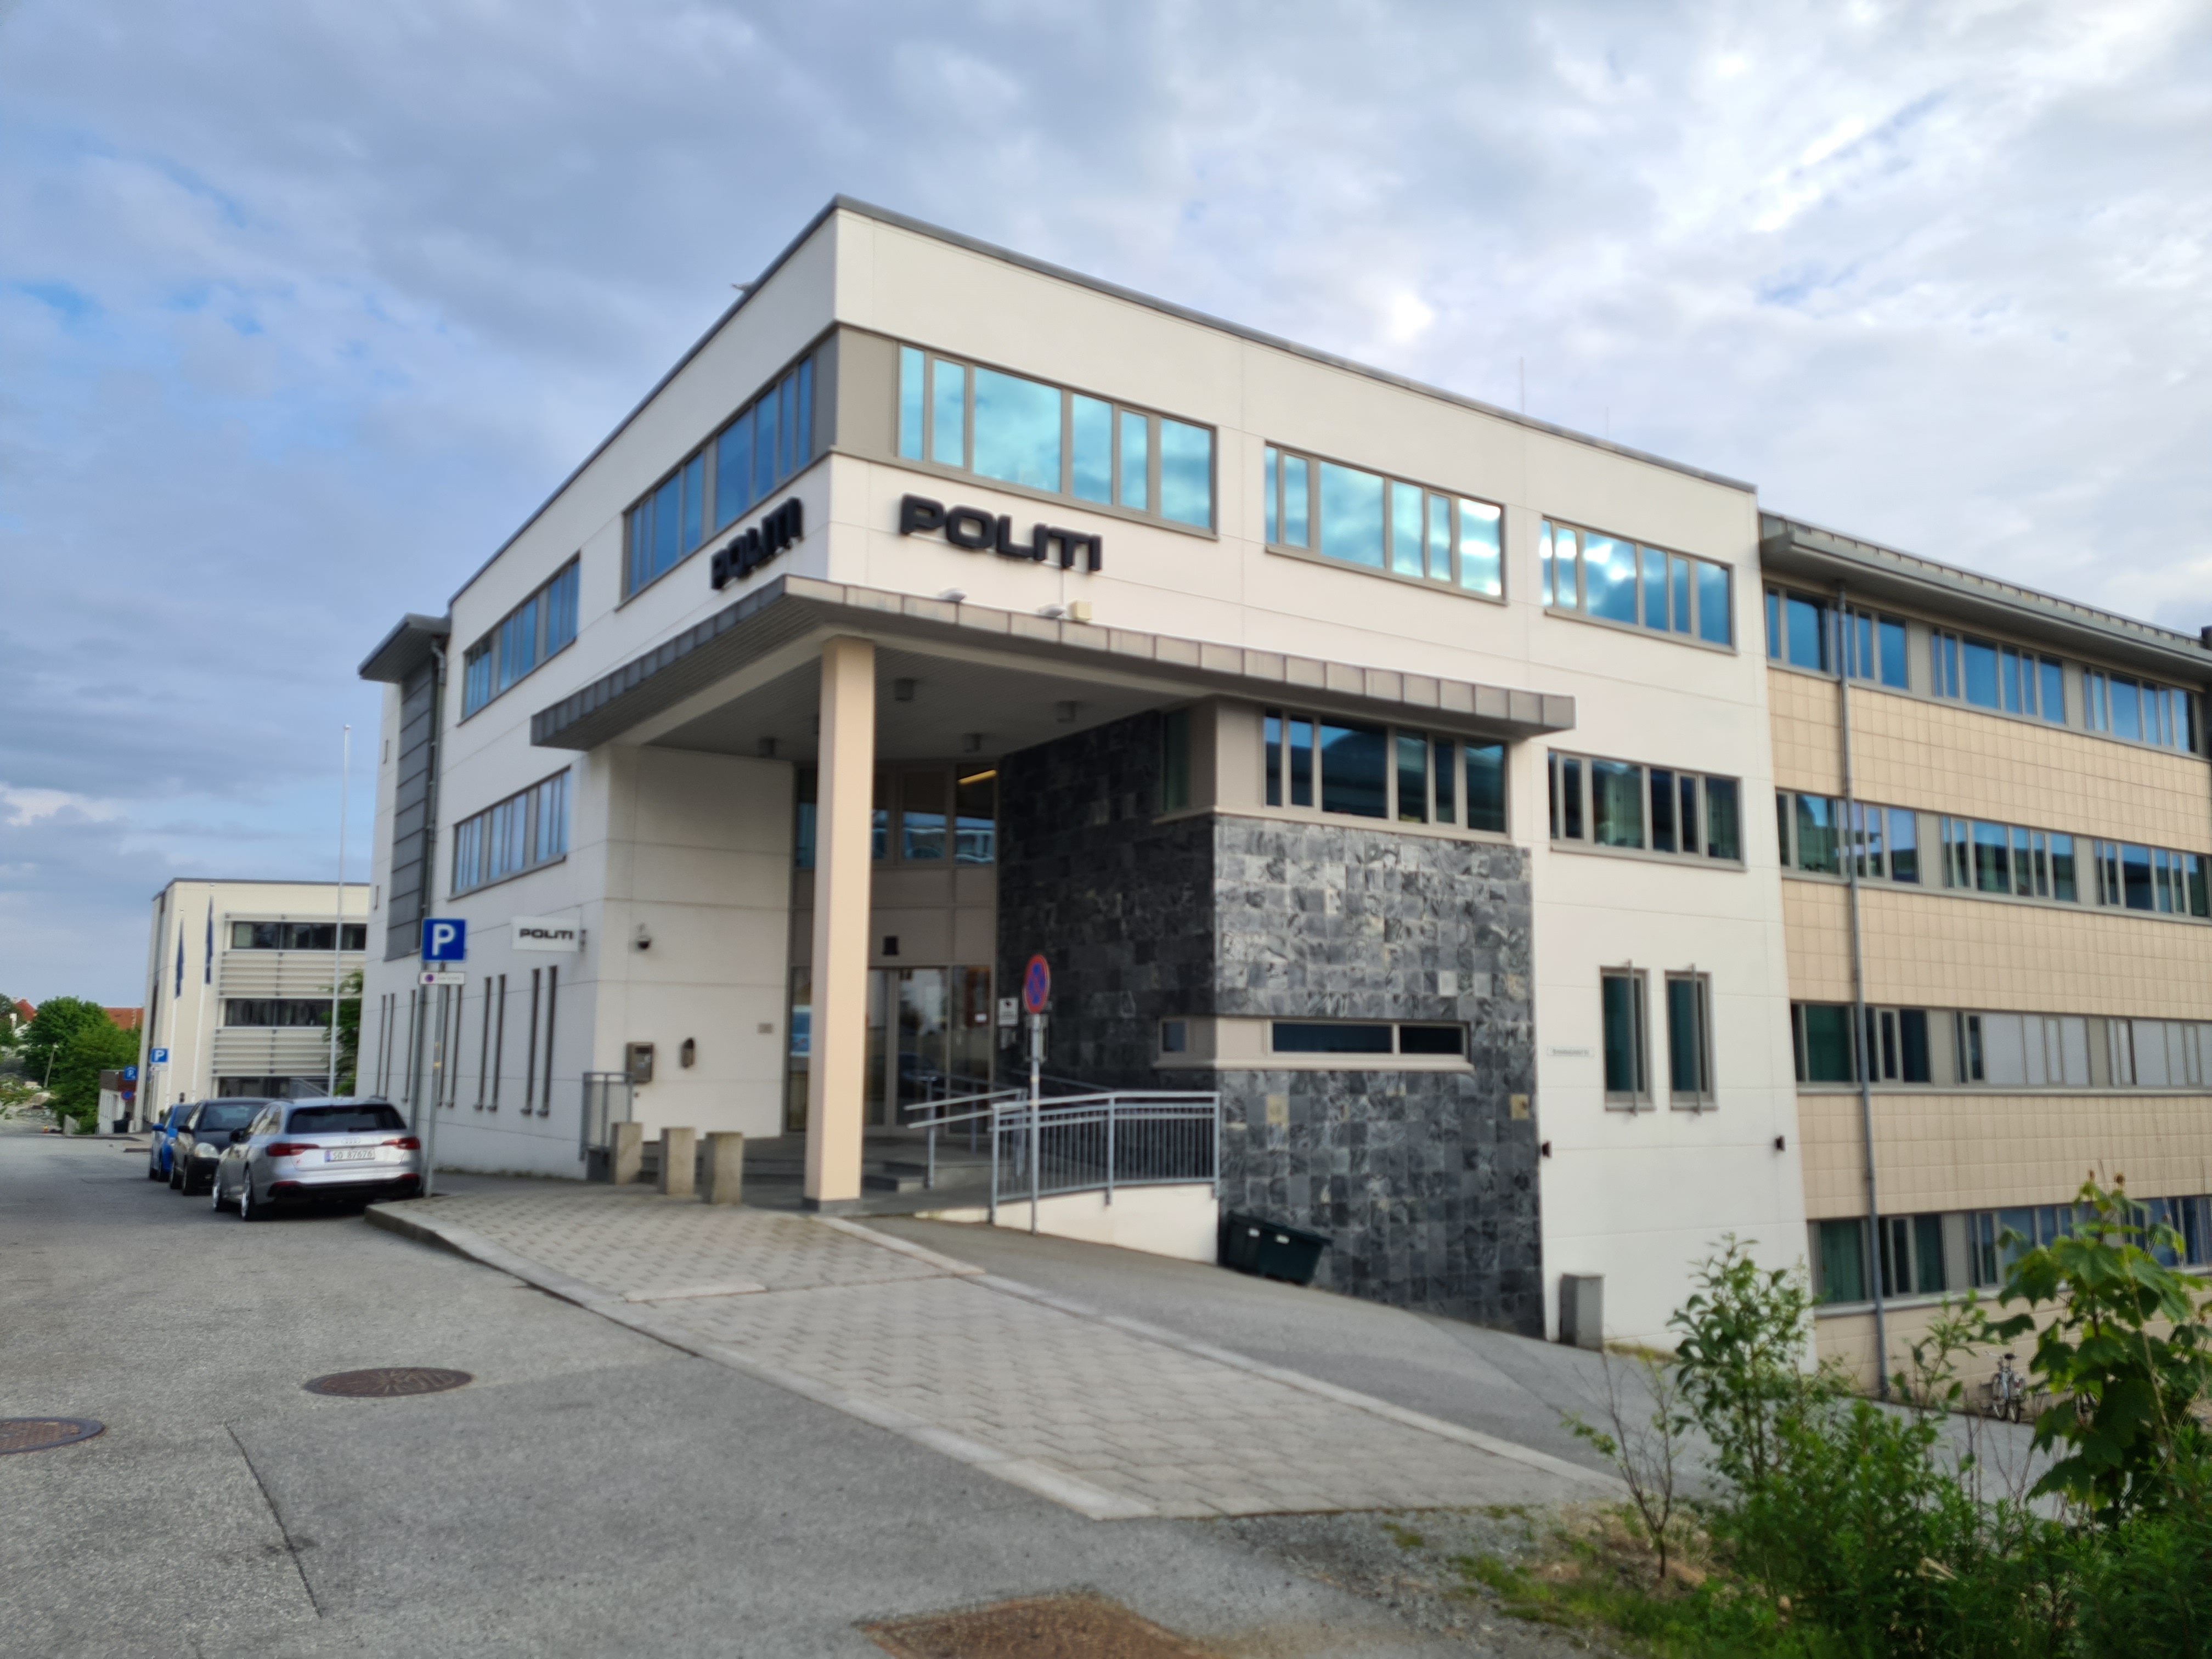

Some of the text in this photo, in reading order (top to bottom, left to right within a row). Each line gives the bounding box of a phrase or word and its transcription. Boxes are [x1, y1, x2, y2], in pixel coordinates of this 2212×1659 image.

[711, 496, 803, 589] POLITI
[901, 494, 1102, 571] POLITI
[432, 923, 455, 956] P
[519, 928, 573, 940] POLITI
[155, 1050, 165, 1062] P
